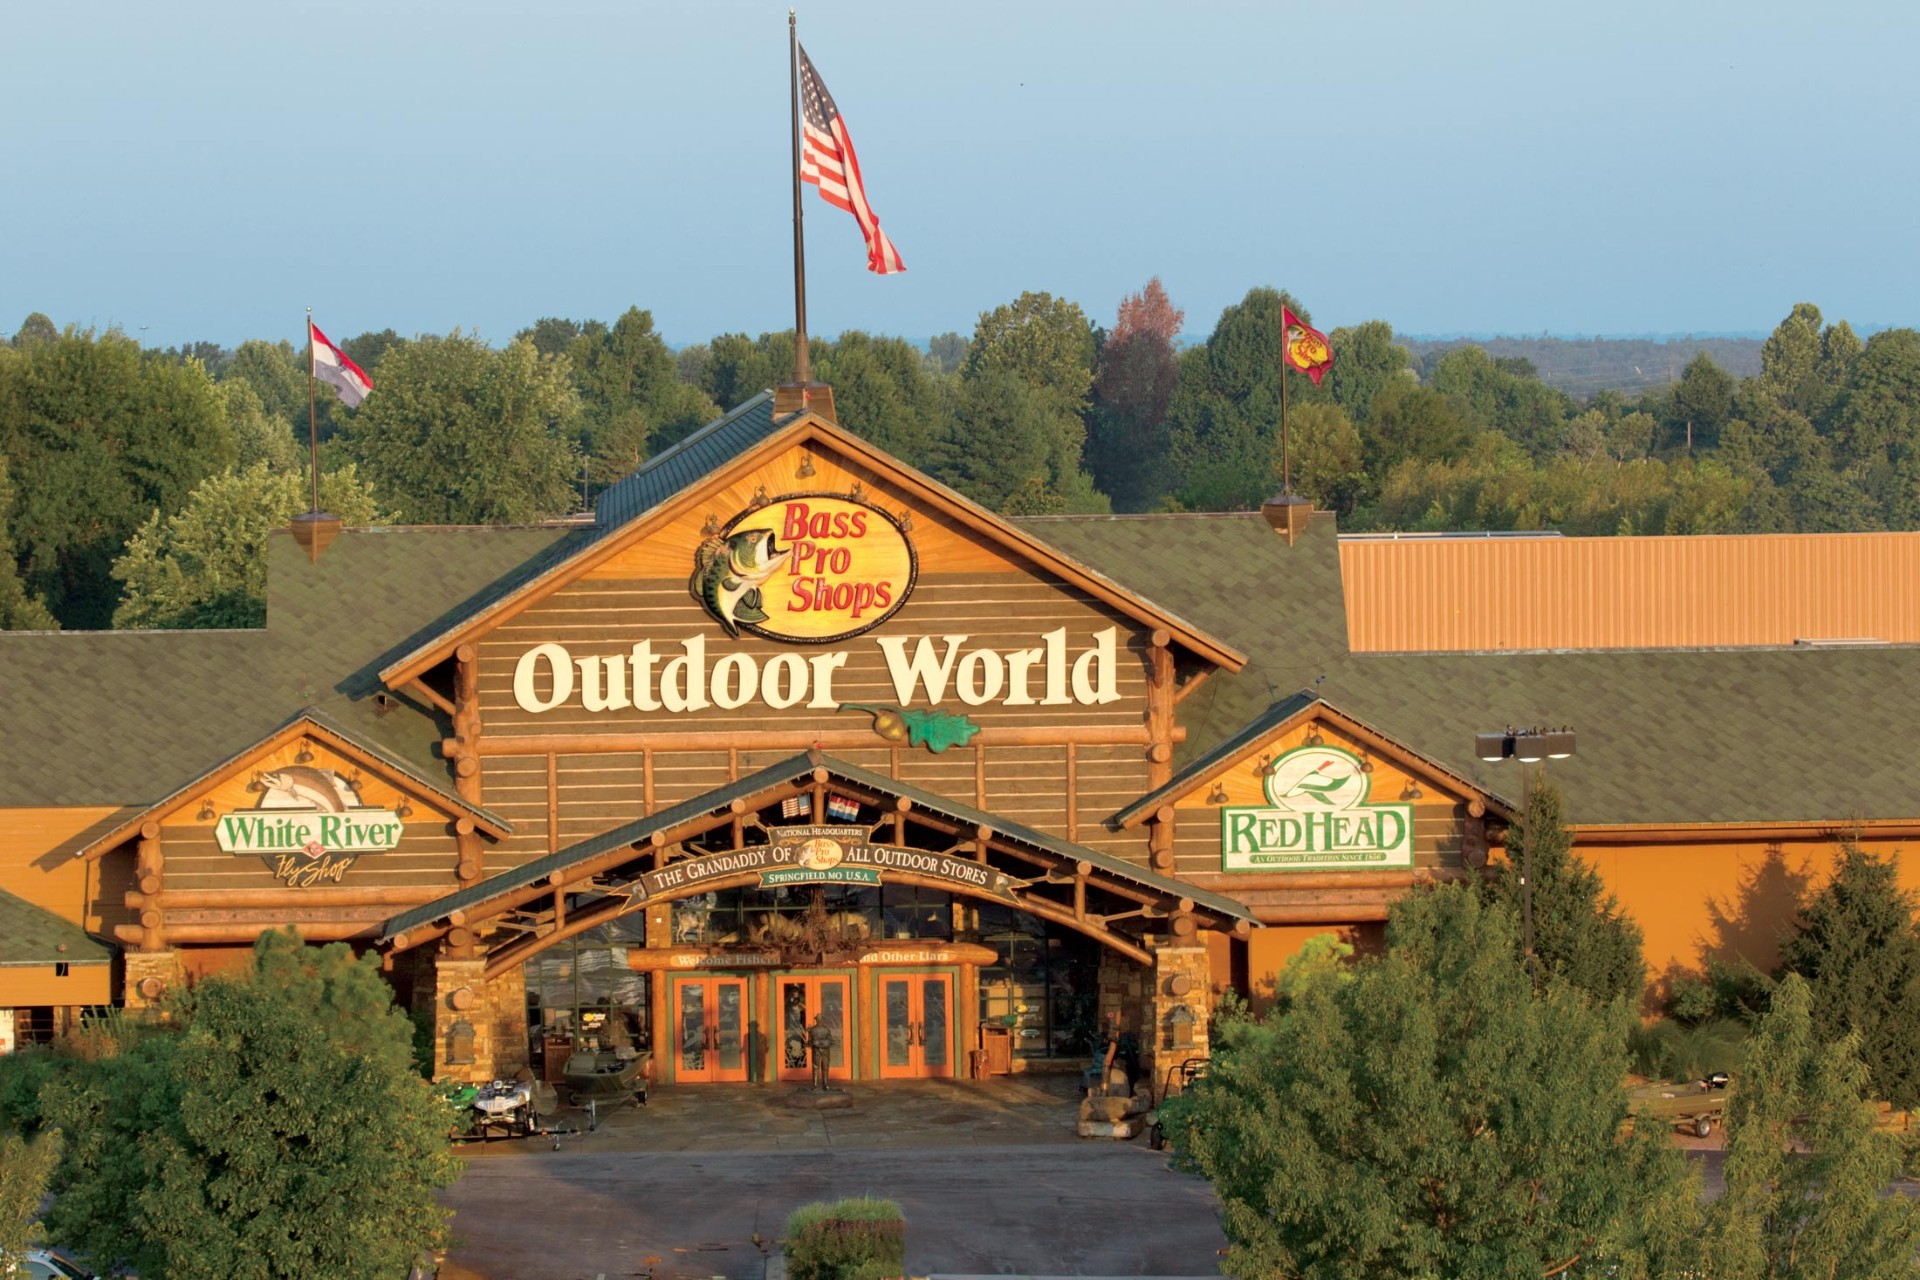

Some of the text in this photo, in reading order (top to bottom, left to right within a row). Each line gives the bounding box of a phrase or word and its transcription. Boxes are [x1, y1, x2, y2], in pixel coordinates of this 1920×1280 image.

[781, 502, 867, 541] Bass
[787, 541, 851, 576] Pro
[787, 576, 891, 618] Shops
[513, 626, 1122, 713] Outdoor World
[223, 815, 399, 849] White River
[776, 827, 863, 838] NATIONAL HEADQUARTERS
[814, 838, 835, 848] Bass
[814, 855, 840, 866] Shops
[815, 847, 830, 857] Pro
[274, 854, 353, 887] Fly Shop
[653, 846, 988, 889] THE GRANDADDY OF ALL OUTDOOR STORES
[828, 872, 842, 880] MO
[846, 871, 871, 881] U.S.A.
[678, 953, 732, 965] Welcome
[861, 951, 949, 962] nd Other Liars
